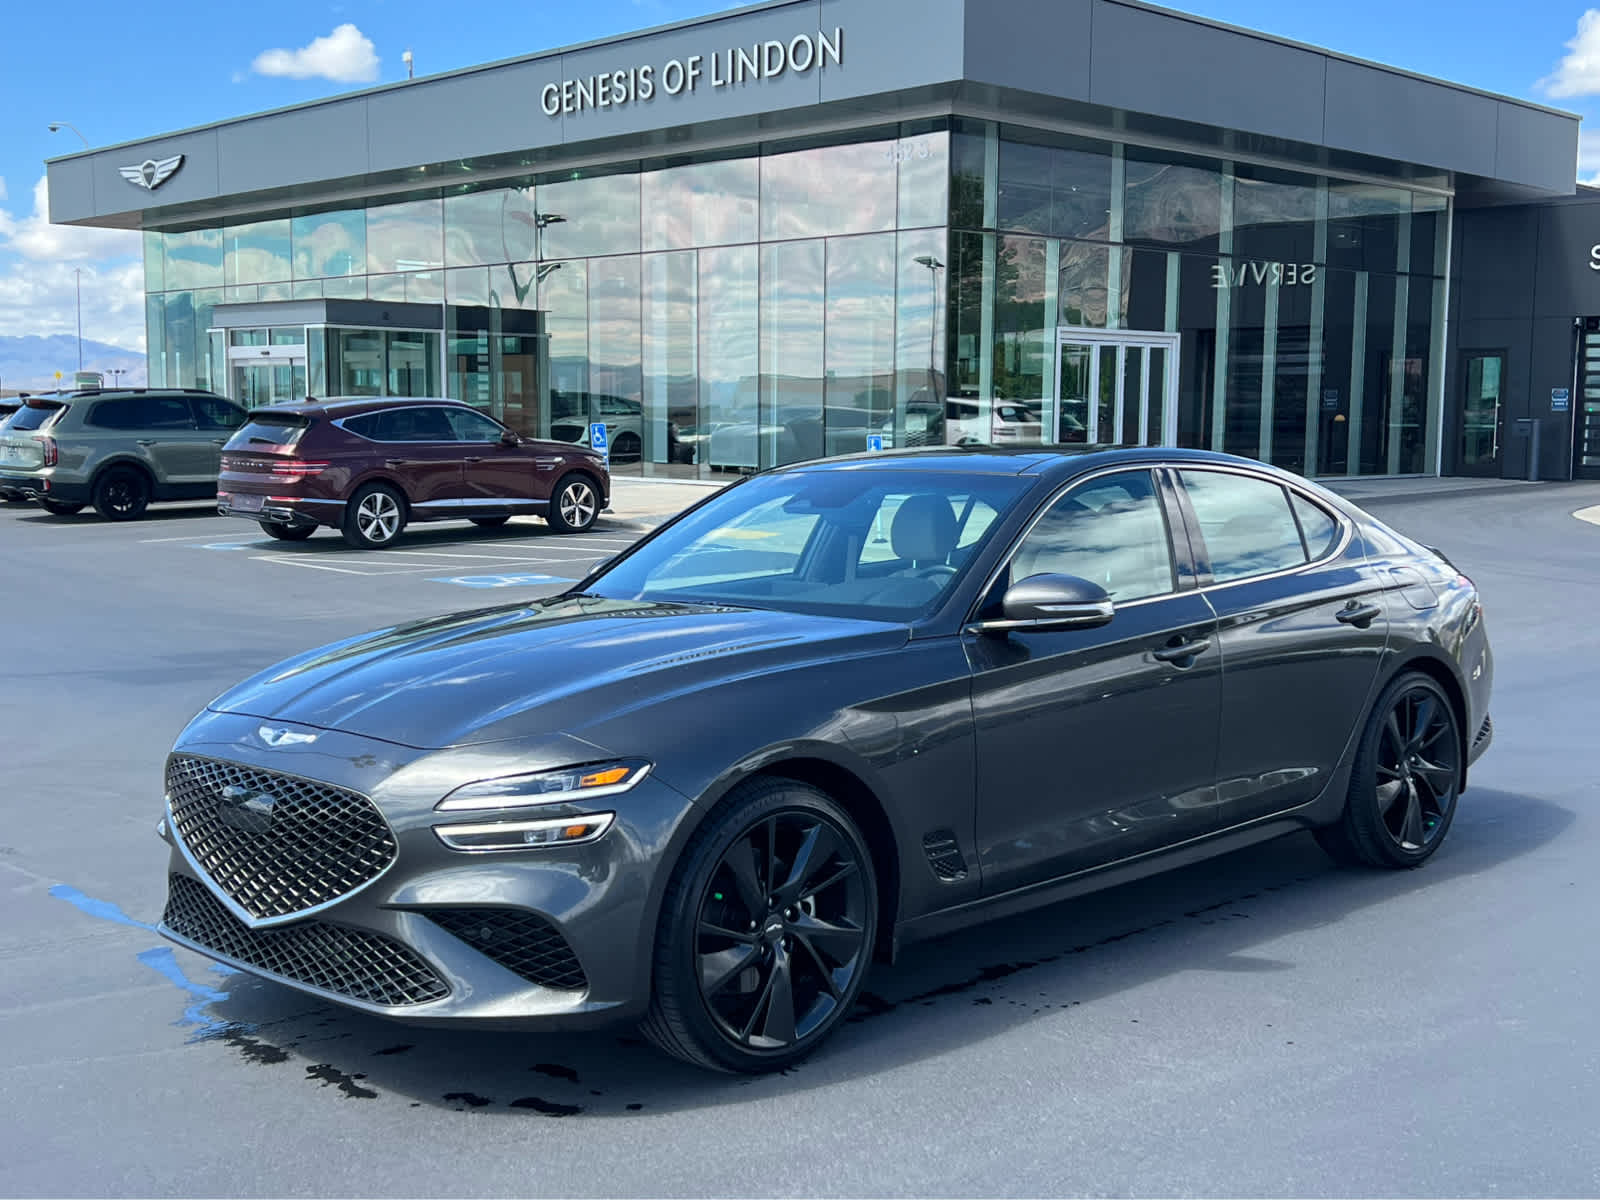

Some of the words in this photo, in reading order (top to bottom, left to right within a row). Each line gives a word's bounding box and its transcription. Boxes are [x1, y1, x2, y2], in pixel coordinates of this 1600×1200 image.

[541, 64, 654, 115] GENESIS
[663, 55, 701, 94] OF
[711, 27, 843, 86] LINDON
